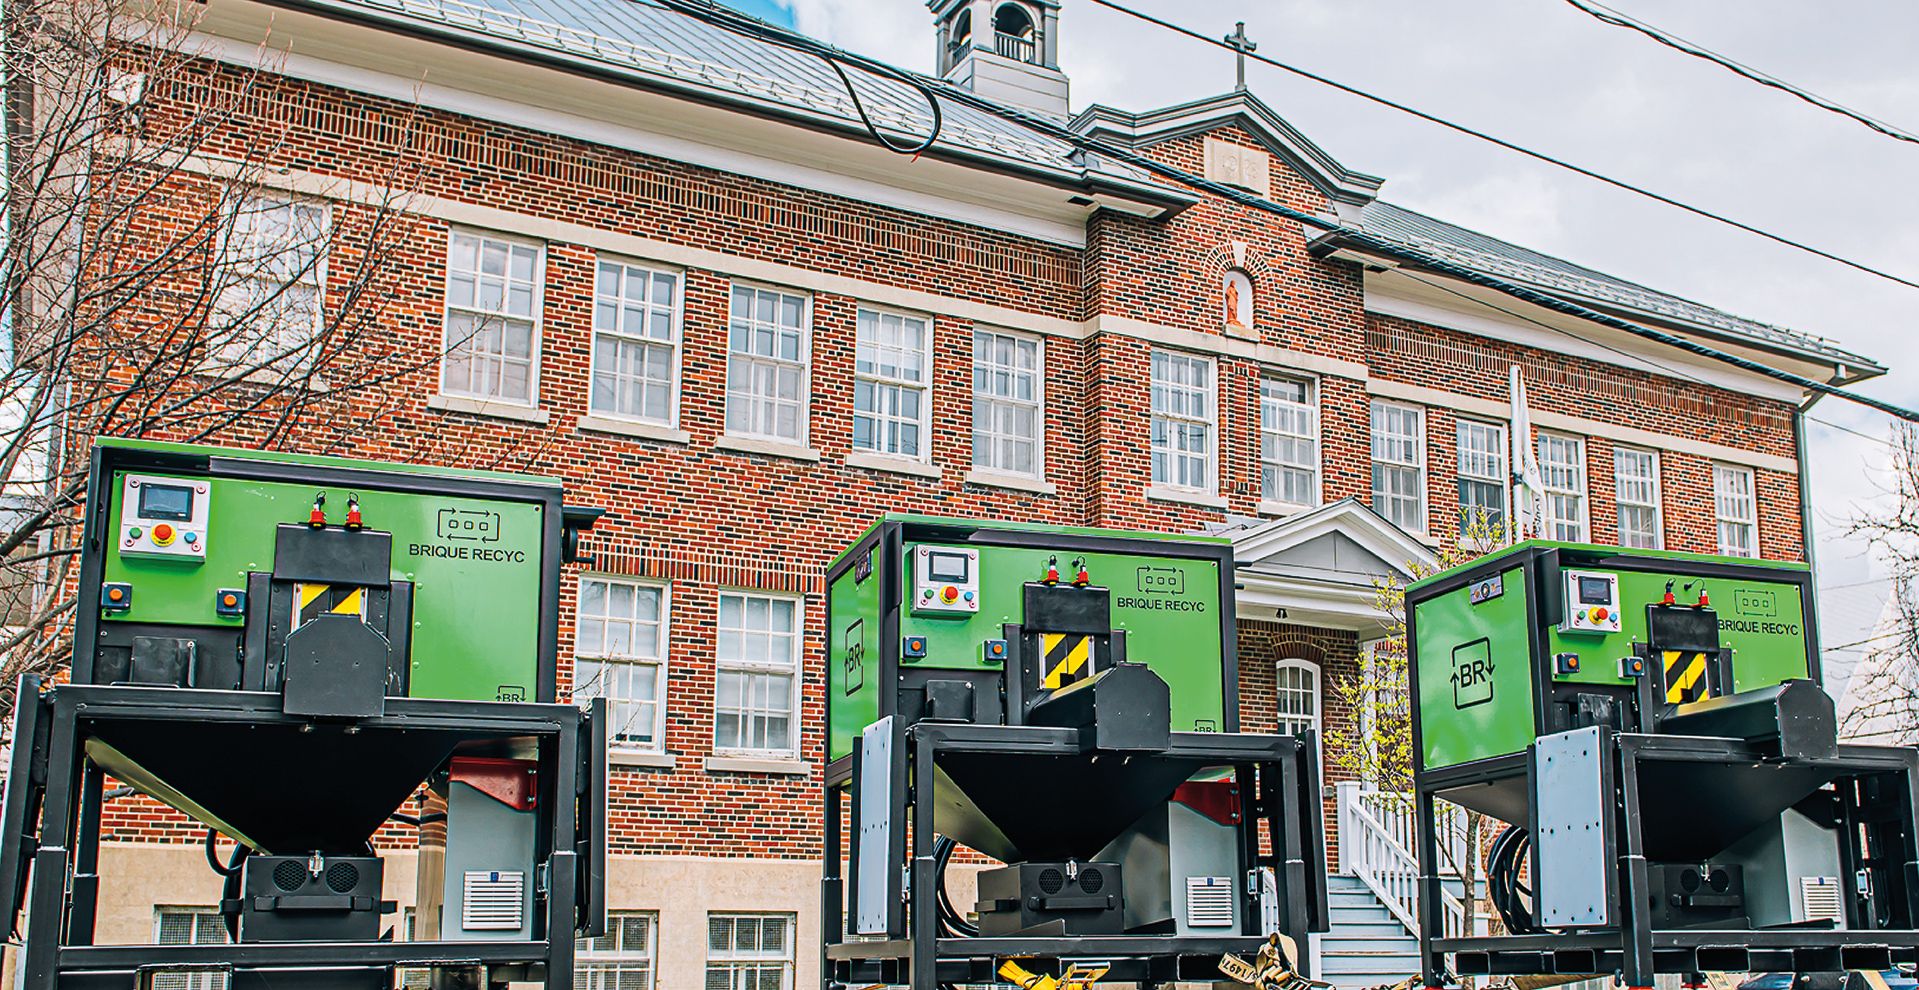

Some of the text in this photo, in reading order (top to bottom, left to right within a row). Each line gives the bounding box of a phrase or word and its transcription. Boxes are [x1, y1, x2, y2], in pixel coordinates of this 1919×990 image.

[409, 543, 526, 563] BRIQUE RECYC
[1117, 597, 1206, 612] BRIQUE RECYC
[1718, 619, 1799, 636] BRIQUE RECYC
[848, 642, 862, 673] BR
[1460, 659, 1487, 689] BR
[502, 693, 520, 703] BR
